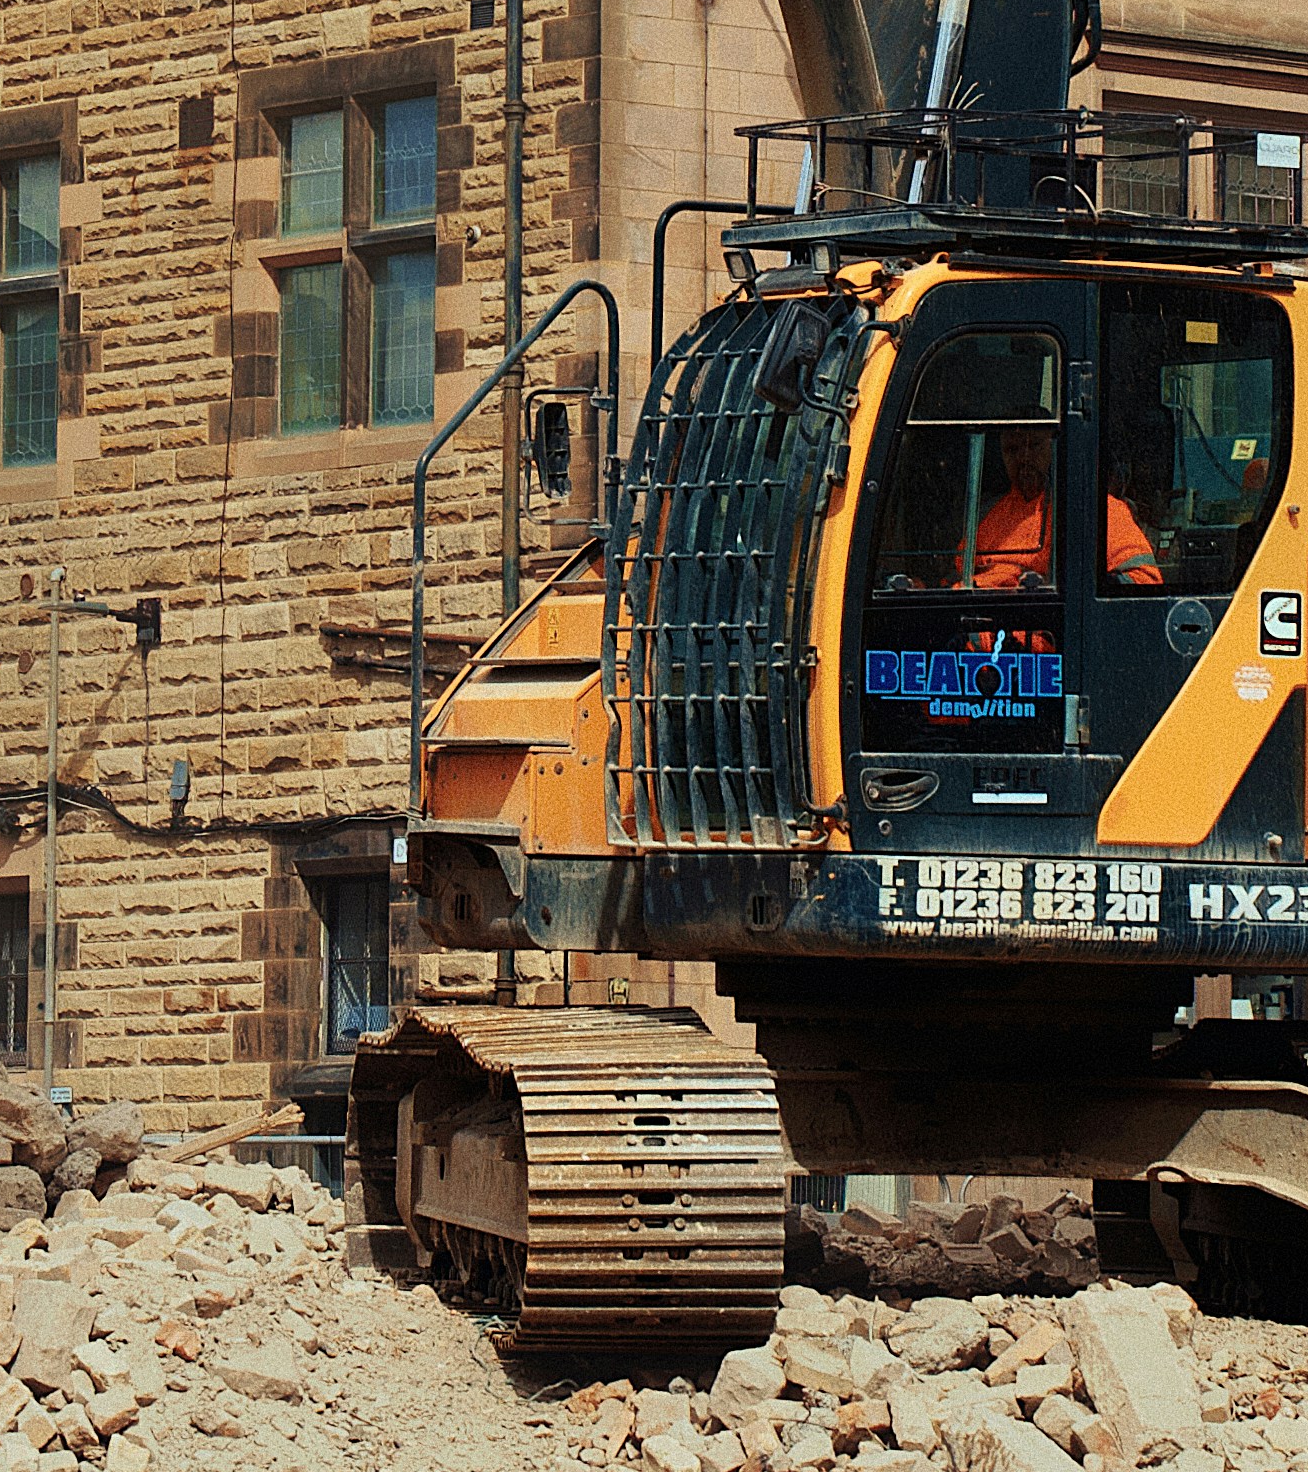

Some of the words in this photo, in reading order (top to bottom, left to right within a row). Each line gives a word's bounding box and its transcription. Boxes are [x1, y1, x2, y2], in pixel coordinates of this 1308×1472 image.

[866, 650, 1063, 697] BEATTIE
[929, 698, 1036, 719] demolition
[877, 858, 905, 887] T.
[918, 860, 1024, 891] 01236
[1034, 861, 1097, 892] 823
[1106, 864, 1162, 893] 160
[878, 888, 903, 916] F.
[916, 889, 1022, 920] 01236
[1032, 891, 1096, 921] 823
[1105, 893, 1160, 922] 201
